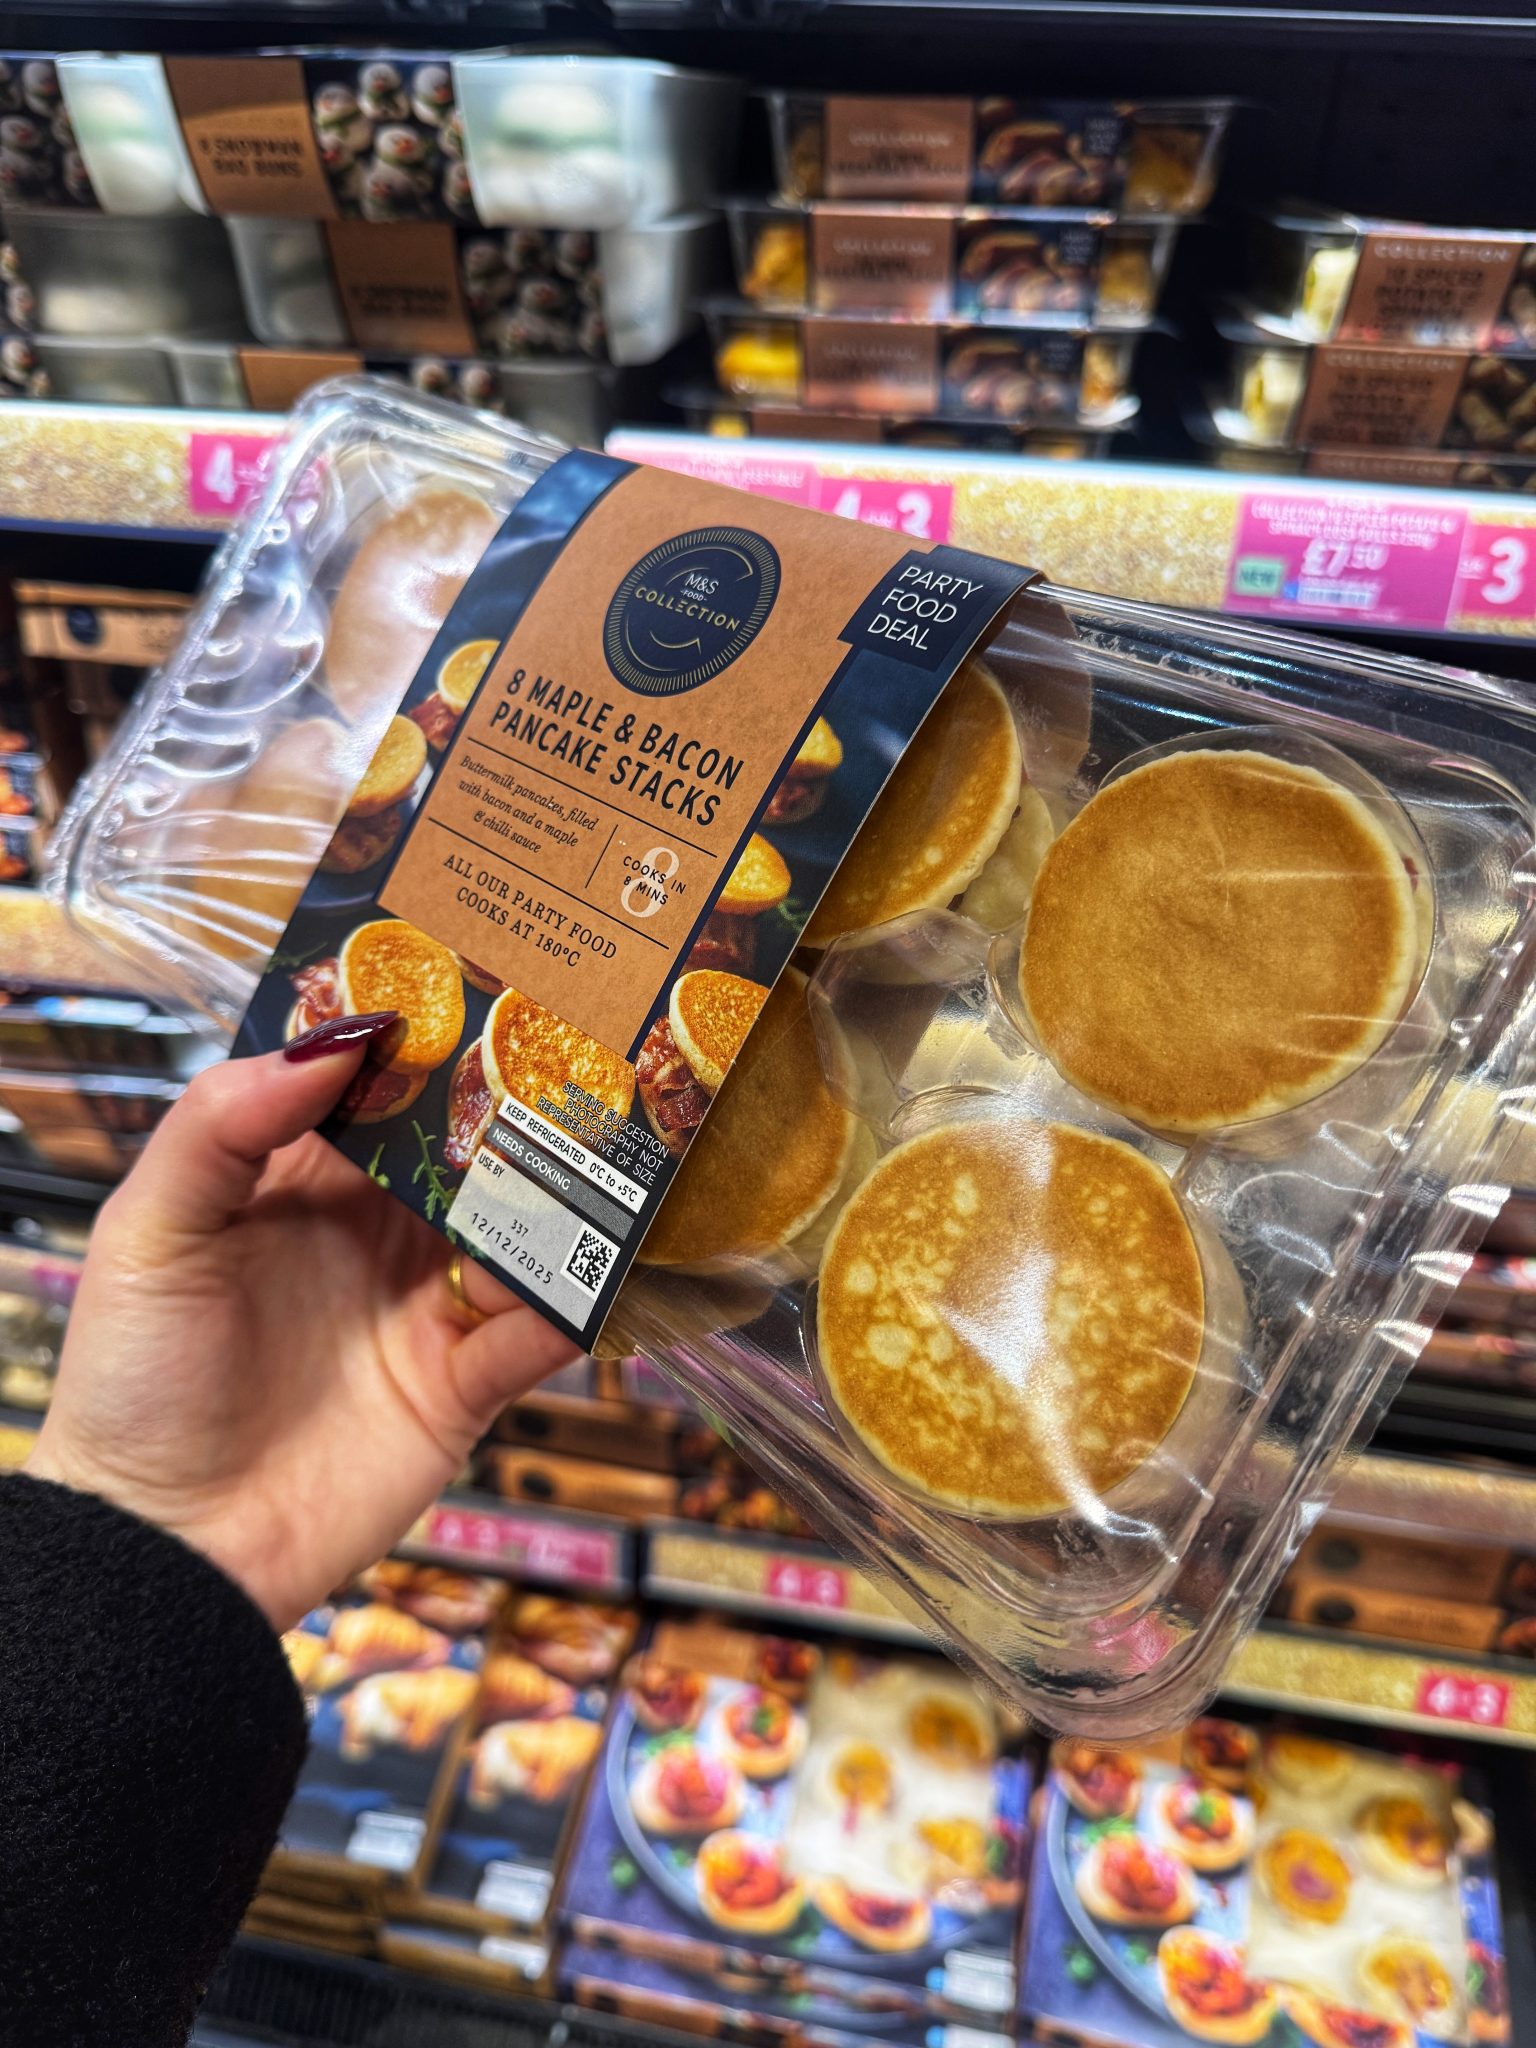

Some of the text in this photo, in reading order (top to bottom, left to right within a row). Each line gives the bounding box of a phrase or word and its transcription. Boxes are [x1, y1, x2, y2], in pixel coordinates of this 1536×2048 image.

[1374, 241, 1511, 264] COLLECTION
[203, 442, 237, 503] 4
[684, 572, 719, 595] M&S
[898, 565, 984, 600] PARTY
[1480, 536, 1528, 604] 3
[634, 587, 741, 632] COLLECTION
[867, 613, 931, 651] DEAL
[881, 587, 957, 623] FOOD
[506, 669, 745, 791] 8 MAPLE & BACON
[460, 755, 600, 832] Buttermilk pancakes, filled
[489, 701, 721, 827] PANCAKE STACKS
[457, 778, 579, 848] with bacon and a maple
[473, 809, 543, 854] & chilli sauce
[443, 853, 617, 960] ALL OUR PARTY FOOD
[622, 855, 688, 895] COOKS IN
[622, 875, 669, 906] 8 MINS
[456, 886, 582, 968] COOKS AT 180°C
[536, 1096, 658, 1187] REPRESENTATIVE OF SIZE
[562, 1080, 670, 1160] SERVING SUGGESTION
[564, 1097, 664, 1172] PHOTOGRAPHY NOT
[478, 1152, 506, 1179] USE BY
[492, 1128, 571, 1191] NEEDS COOKING
[505, 1102, 639, 1203] KEEP REFRIGERATED 0°C to +5°C
[471, 1212, 555, 1285] 12/12/2025
[510, 1218, 530, 1239] 337
